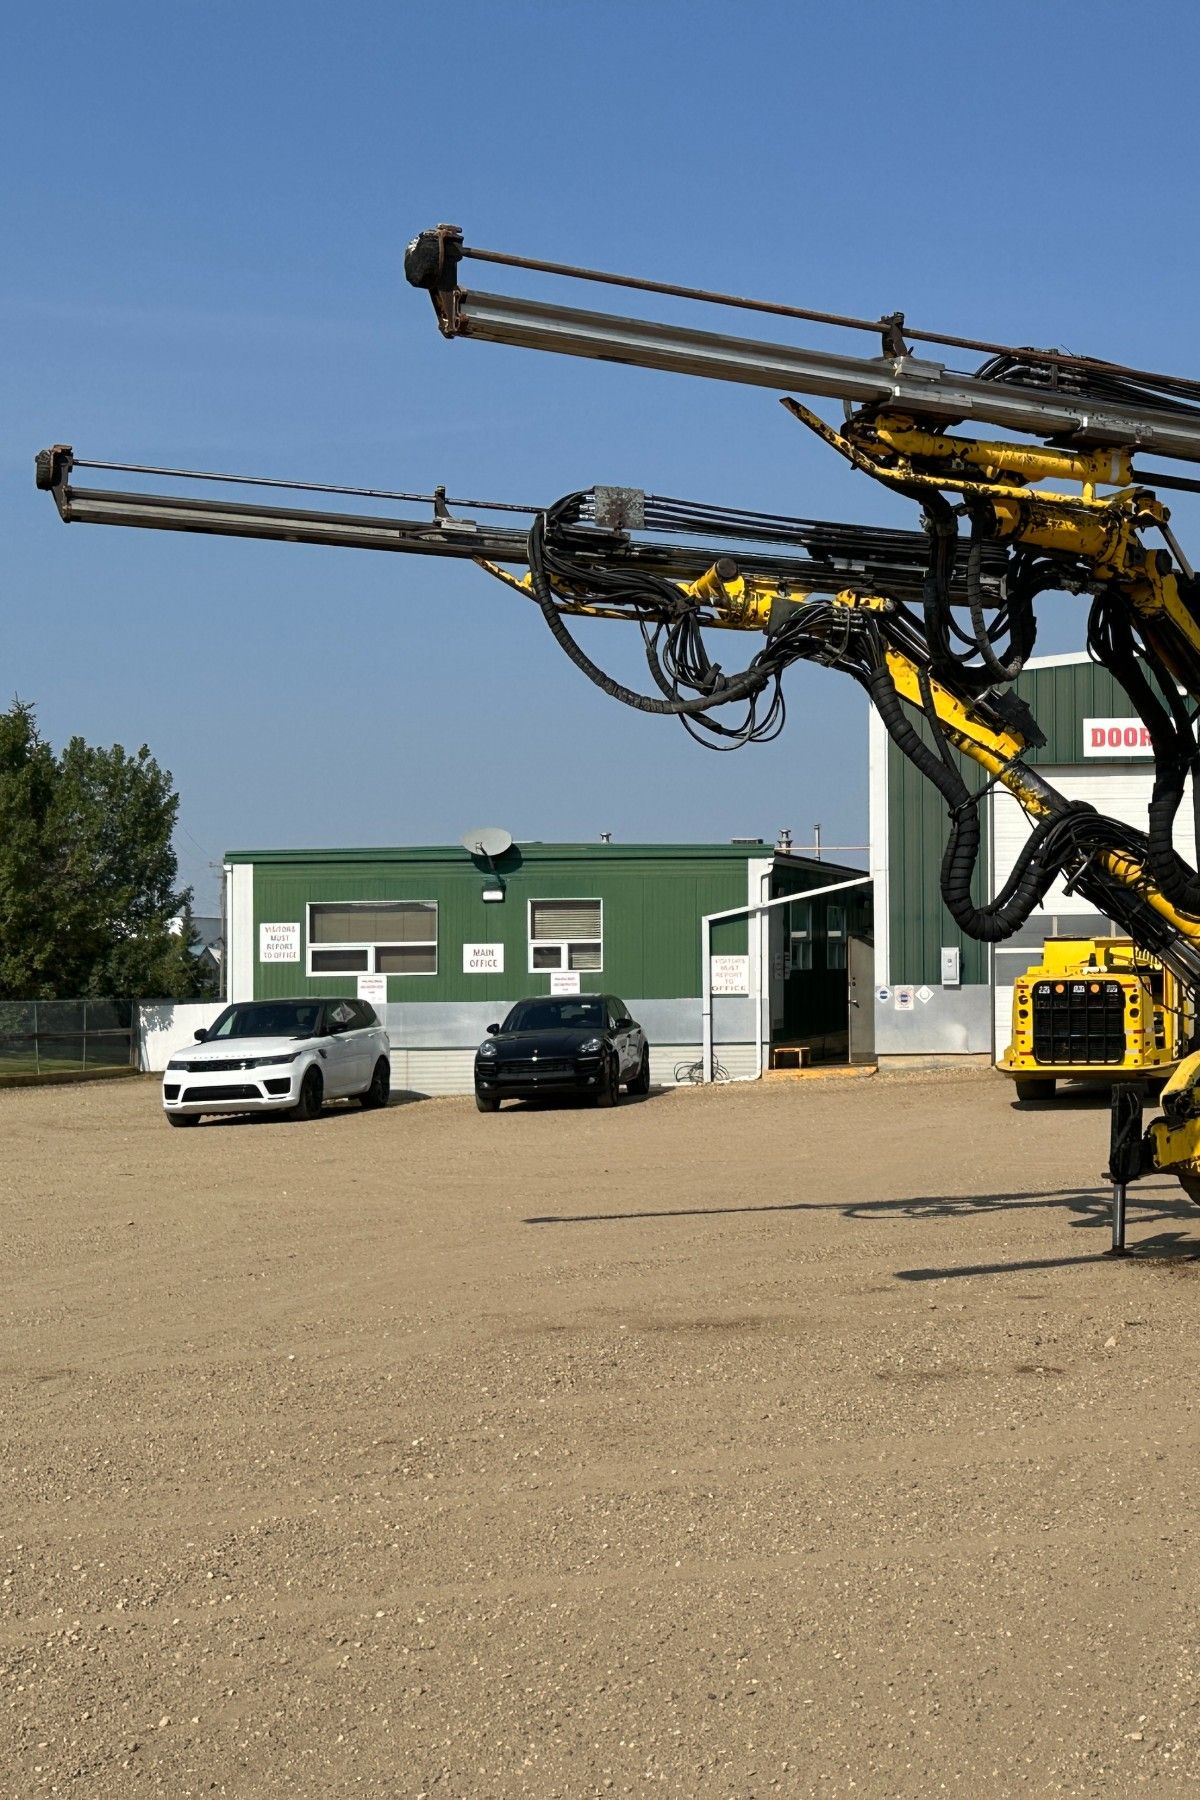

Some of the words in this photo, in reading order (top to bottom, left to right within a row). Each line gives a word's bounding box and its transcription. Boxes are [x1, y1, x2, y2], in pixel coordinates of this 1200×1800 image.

[264, 925, 296, 933] VISITORS
[274, 951, 297, 959] OFFICE
[473, 948, 495, 957] MAIN
[469, 959, 498, 968] OFFICE
